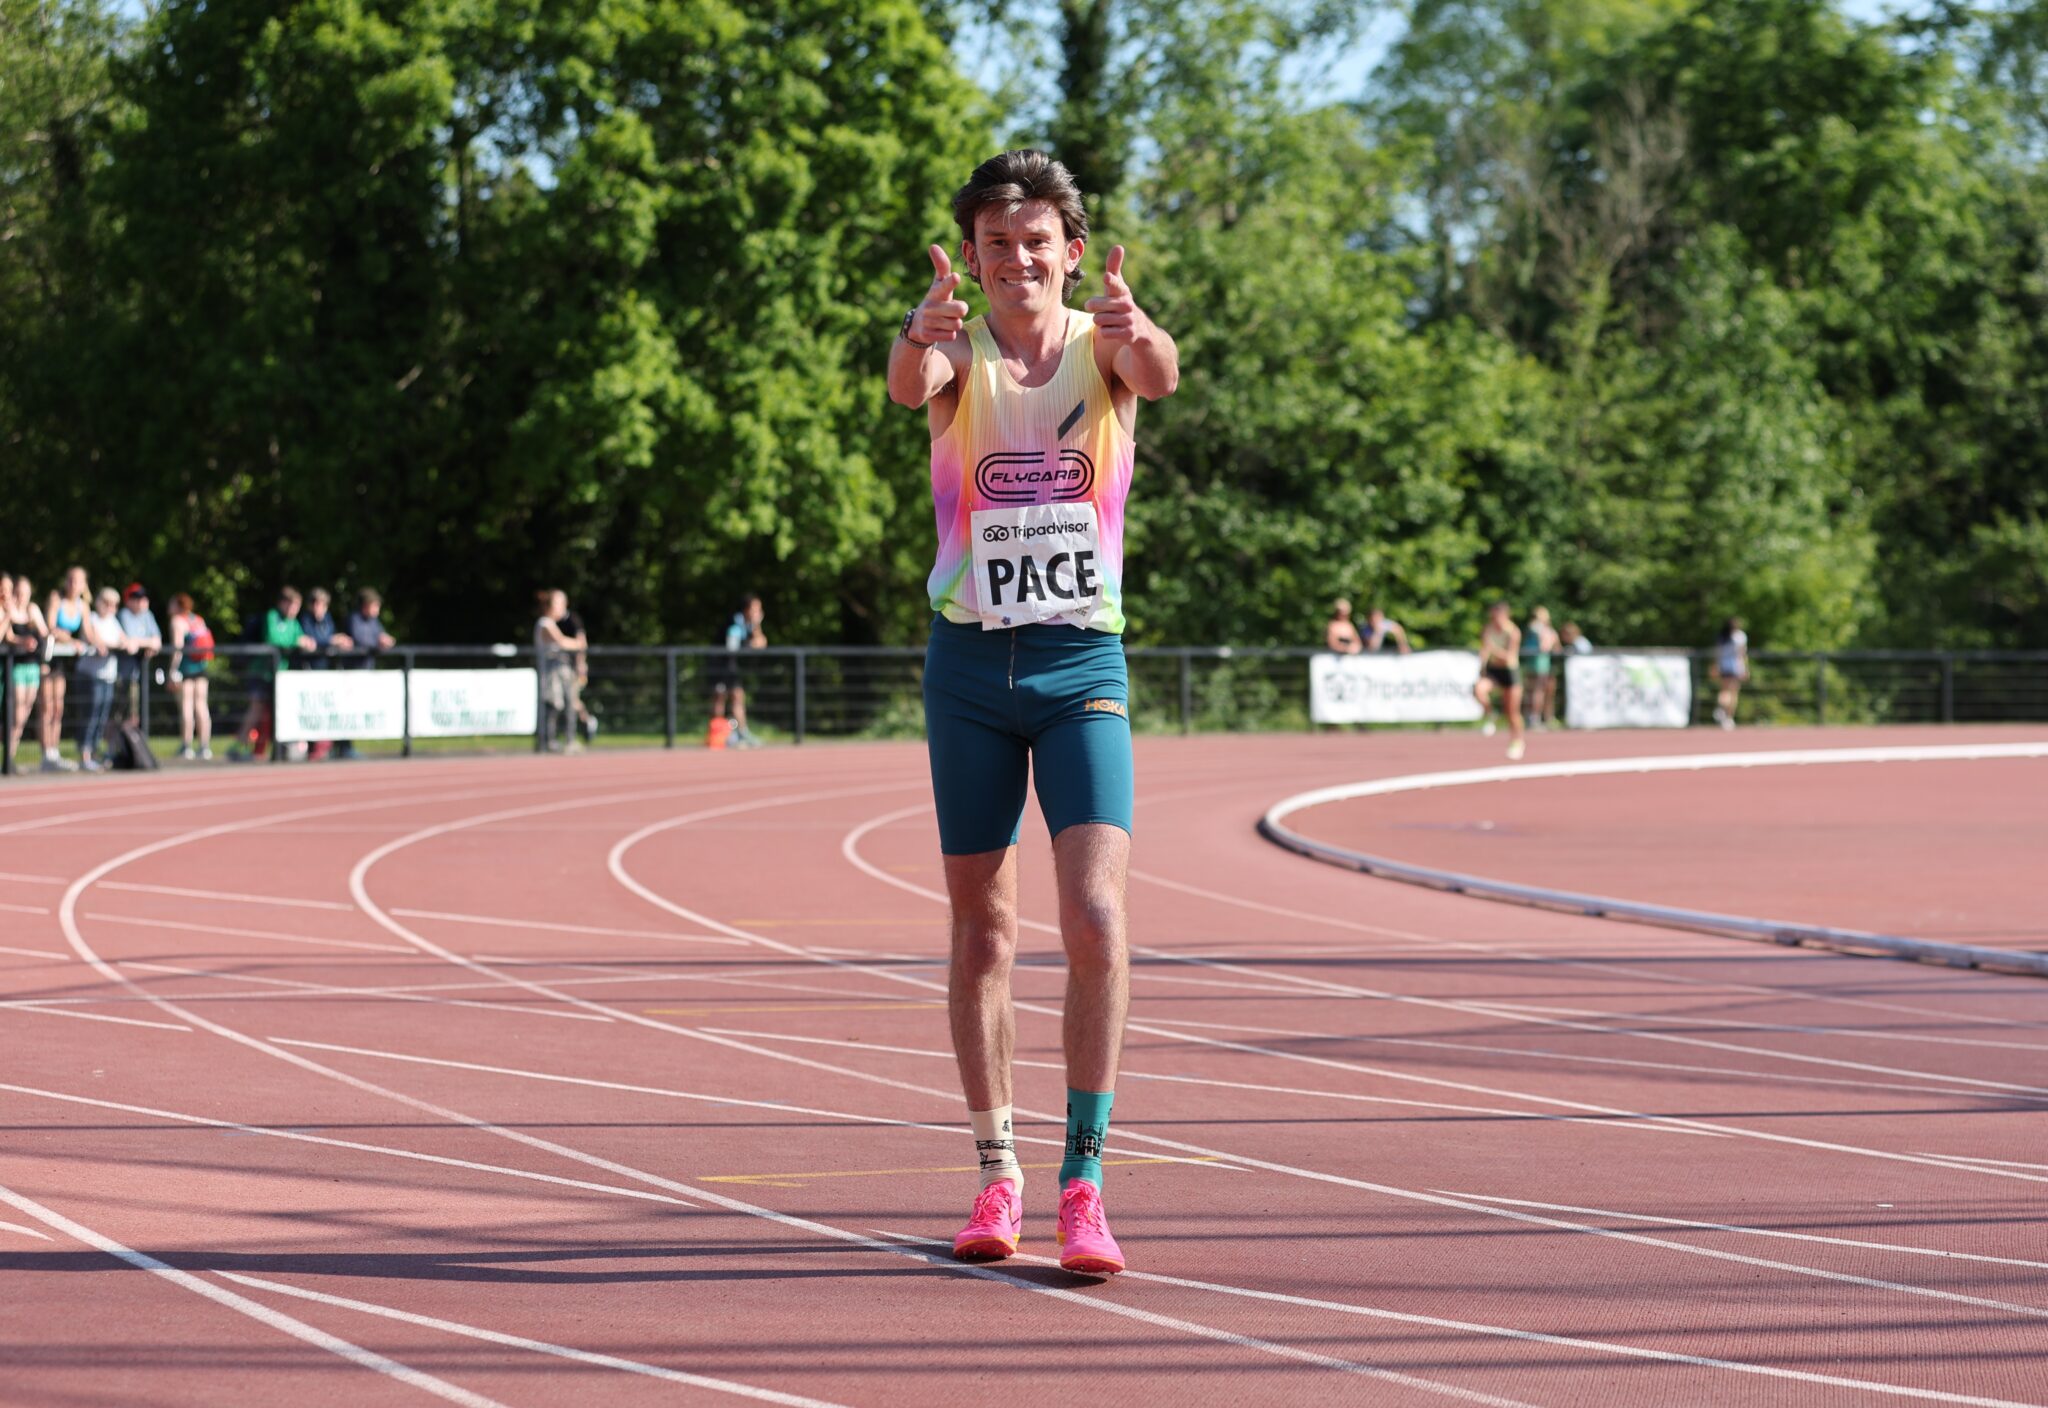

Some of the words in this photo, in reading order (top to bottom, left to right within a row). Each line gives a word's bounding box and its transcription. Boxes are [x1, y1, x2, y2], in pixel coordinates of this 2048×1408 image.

[990, 469, 1081, 483] FLYCARB
[1011, 521, 1089, 539] Tripadvisor
[987, 550, 1097, 606] PACE
